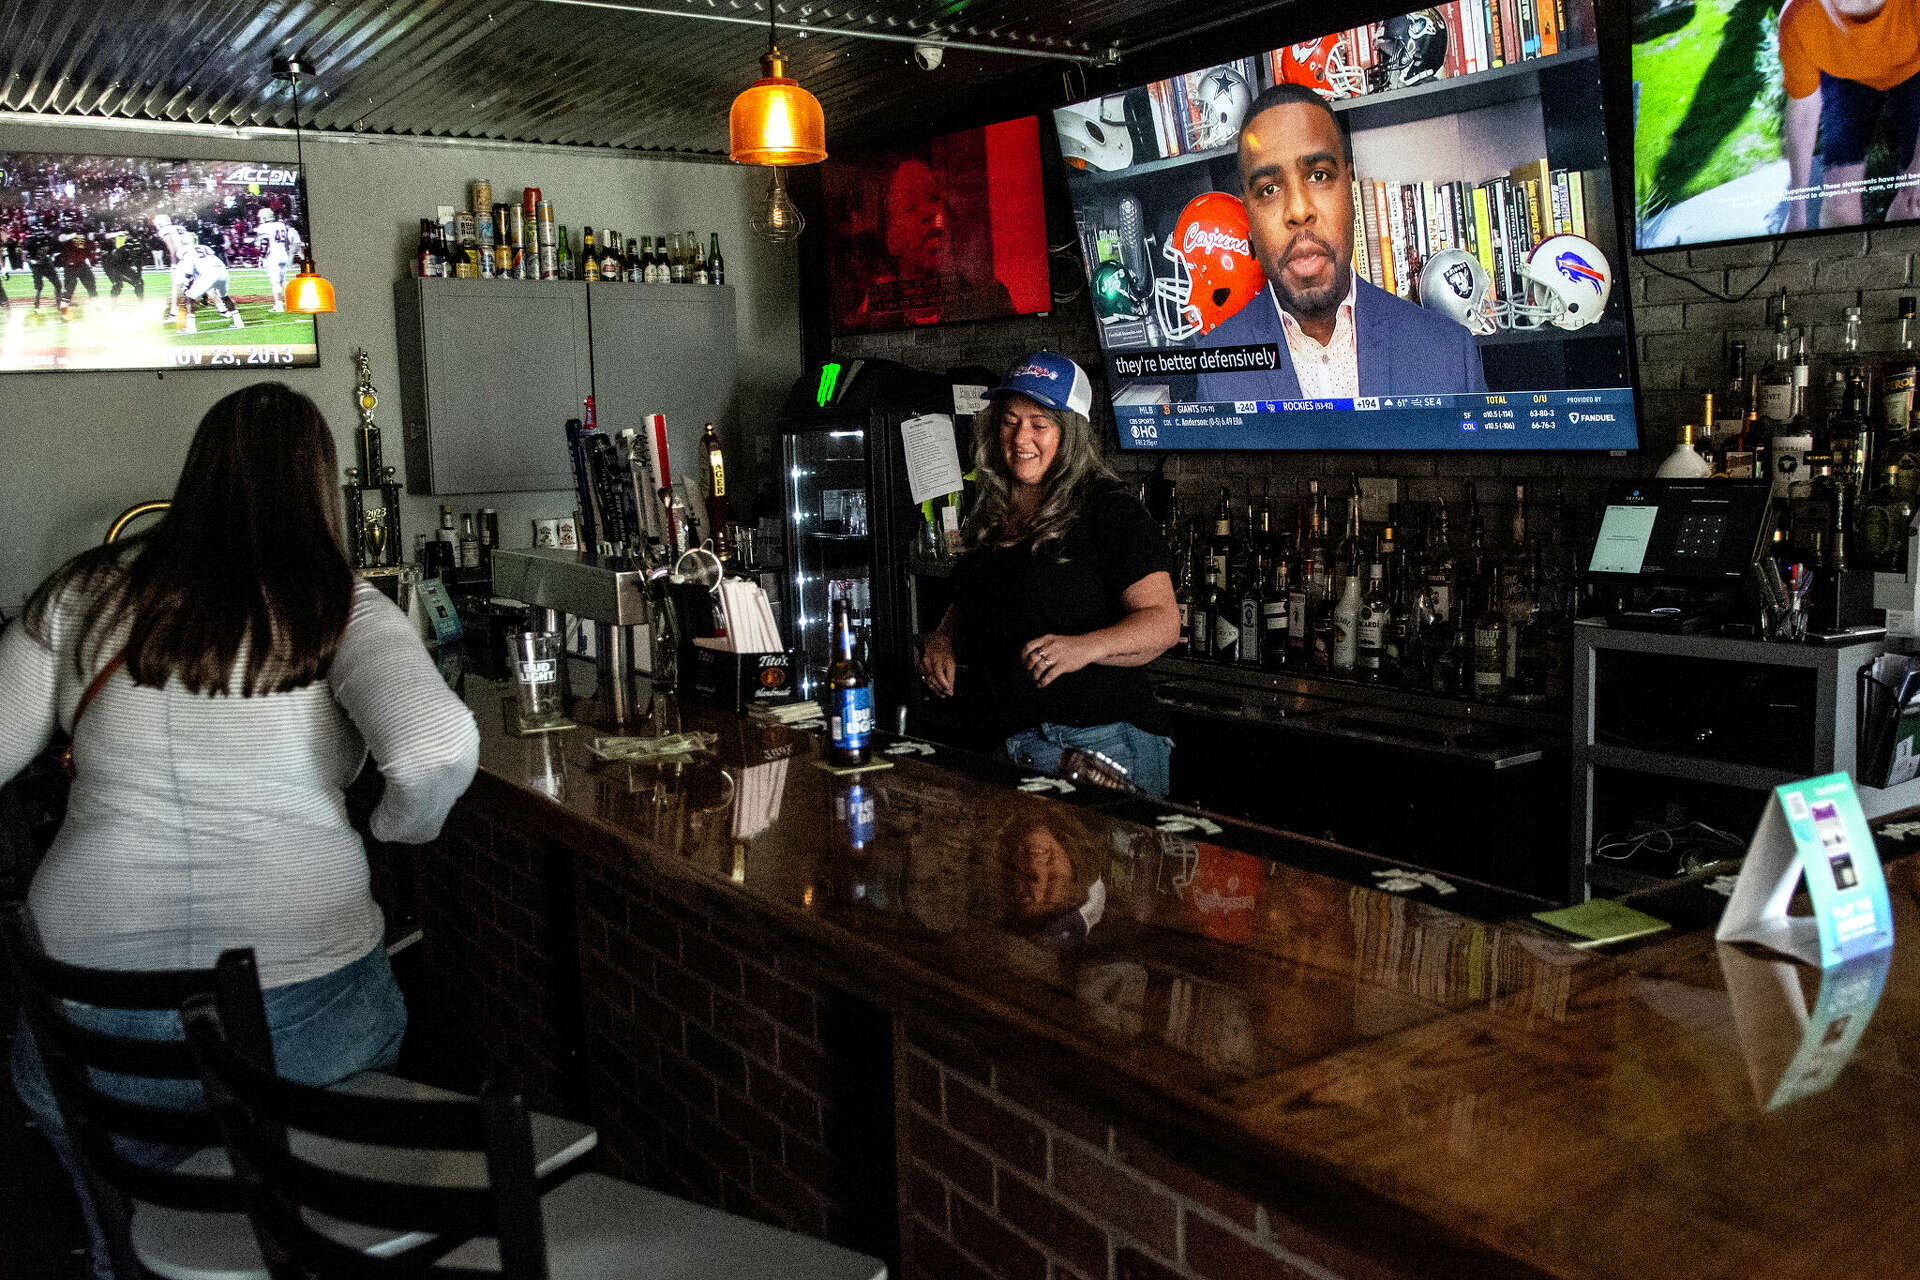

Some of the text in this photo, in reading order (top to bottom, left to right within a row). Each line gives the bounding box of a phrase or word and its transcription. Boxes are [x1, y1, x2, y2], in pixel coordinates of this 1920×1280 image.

[1842, 177, 1877, 188] statements
[1878, 175, 1895, 183] have
[1184, 221, 1250, 256] Cajuns
[211, 347, 241, 367] 23,
[247, 346, 294, 365] 2013
[1116, 347, 1276, 377] they're better defensively
[1356, 399, 1377, 408] +194
[1486, 396, 1507, 404] TOTAL
[1138, 406, 1154, 415] MLB
[1177, 404, 1199, 413] GIANTS
[1238, 403, 1254, 412] -240
[1283, 401, 1314, 411] ROCKIES
[1580, 414, 1616, 422] FANDUEL
[1140, 426, 1158, 439] HQ
[758, 654, 789, 668] Tito's
[523, 662, 551, 673] BUD
[520, 671, 555, 682] LIGHT
